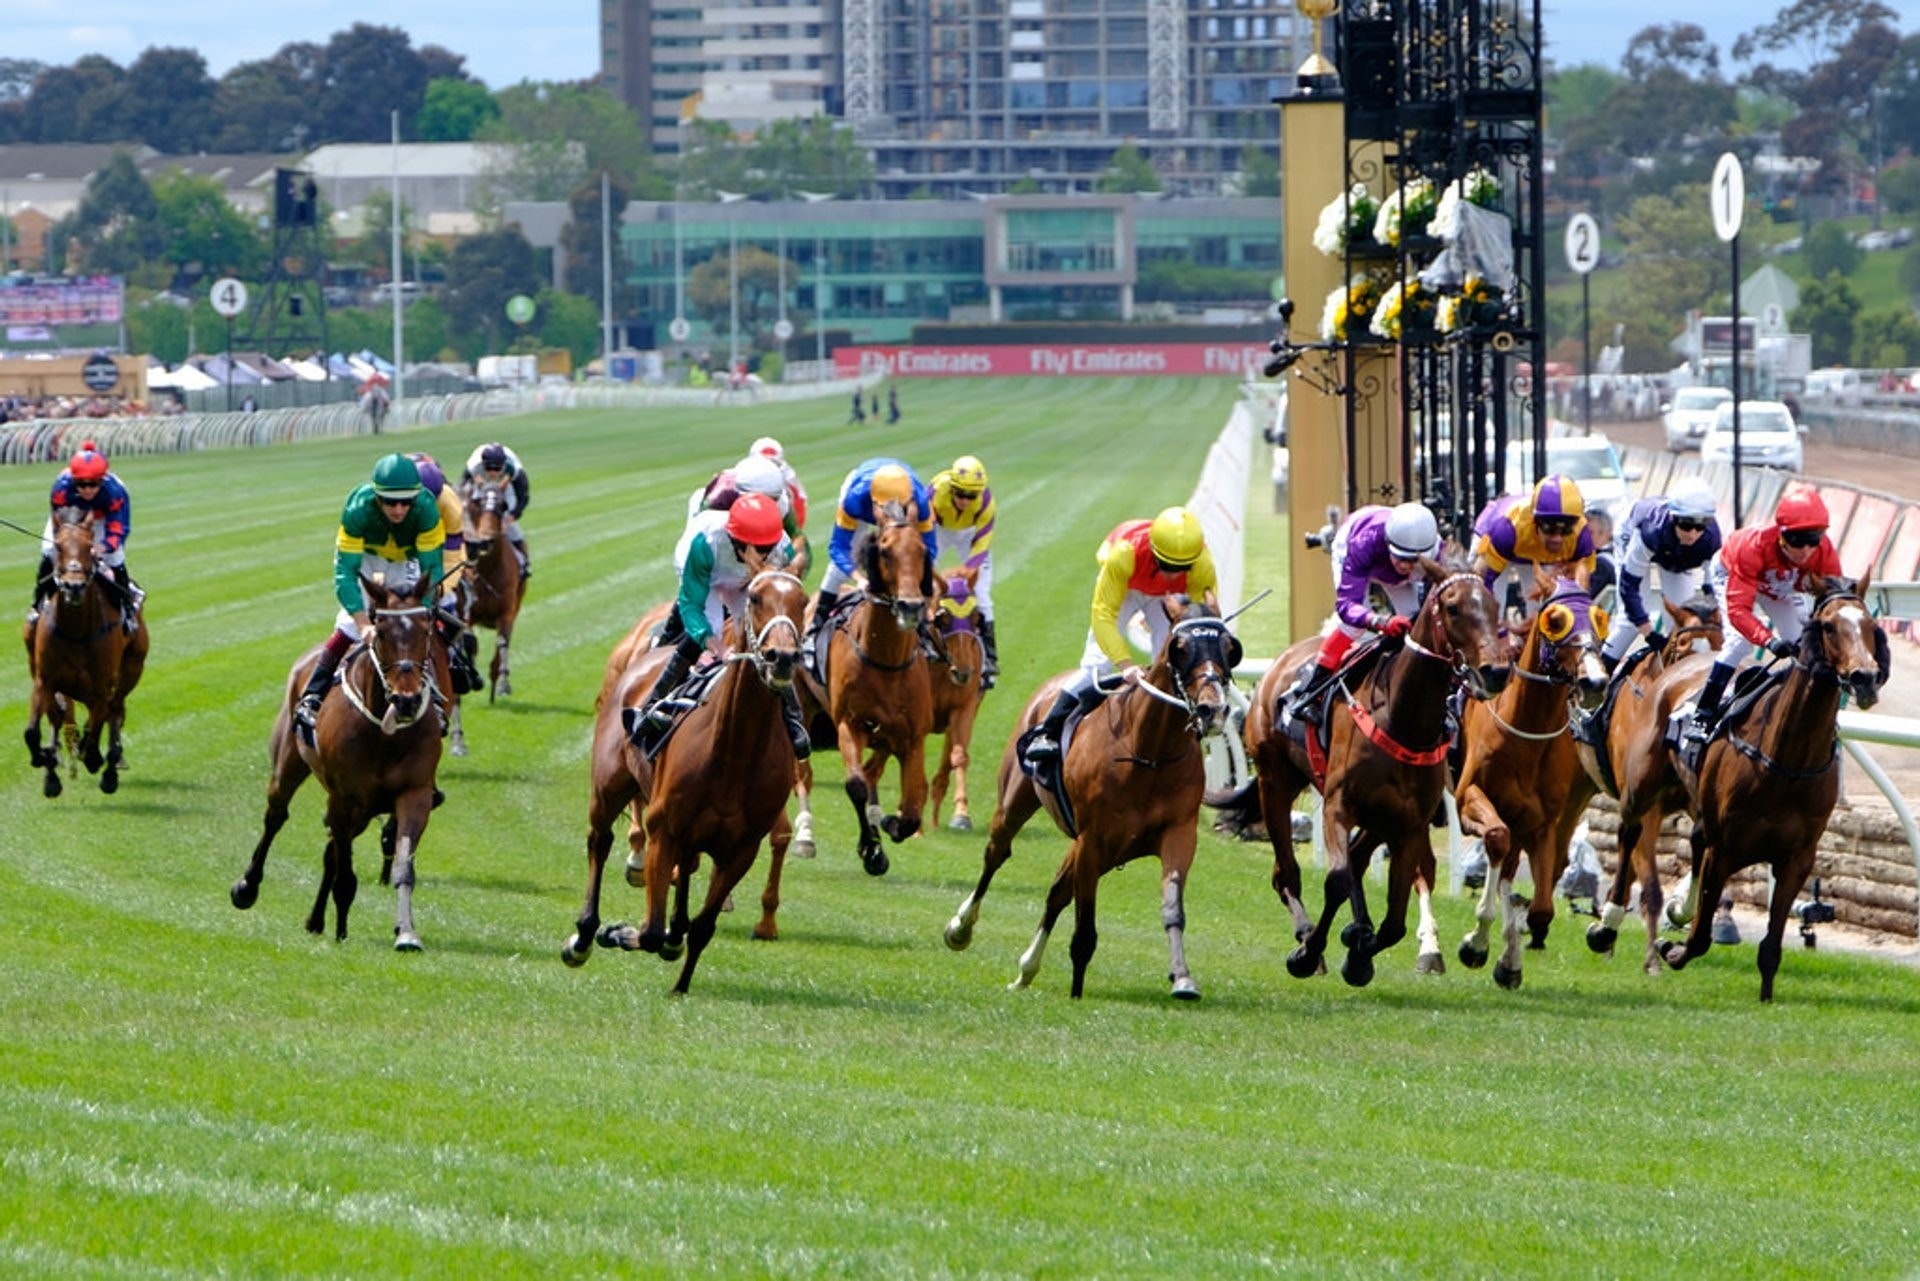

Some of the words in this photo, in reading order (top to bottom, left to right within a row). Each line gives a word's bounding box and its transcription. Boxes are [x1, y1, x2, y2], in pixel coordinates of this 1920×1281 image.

[1721, 165, 1731, 224] 1
[1575, 222, 1591, 261] 2
[220, 284, 238, 308] 4
[899, 350, 991, 372] Emirates
[1030, 349, 1068, 374] Fly
[1072, 348, 1166, 371] Emirates
[1204, 347, 1239, 373] Fly
